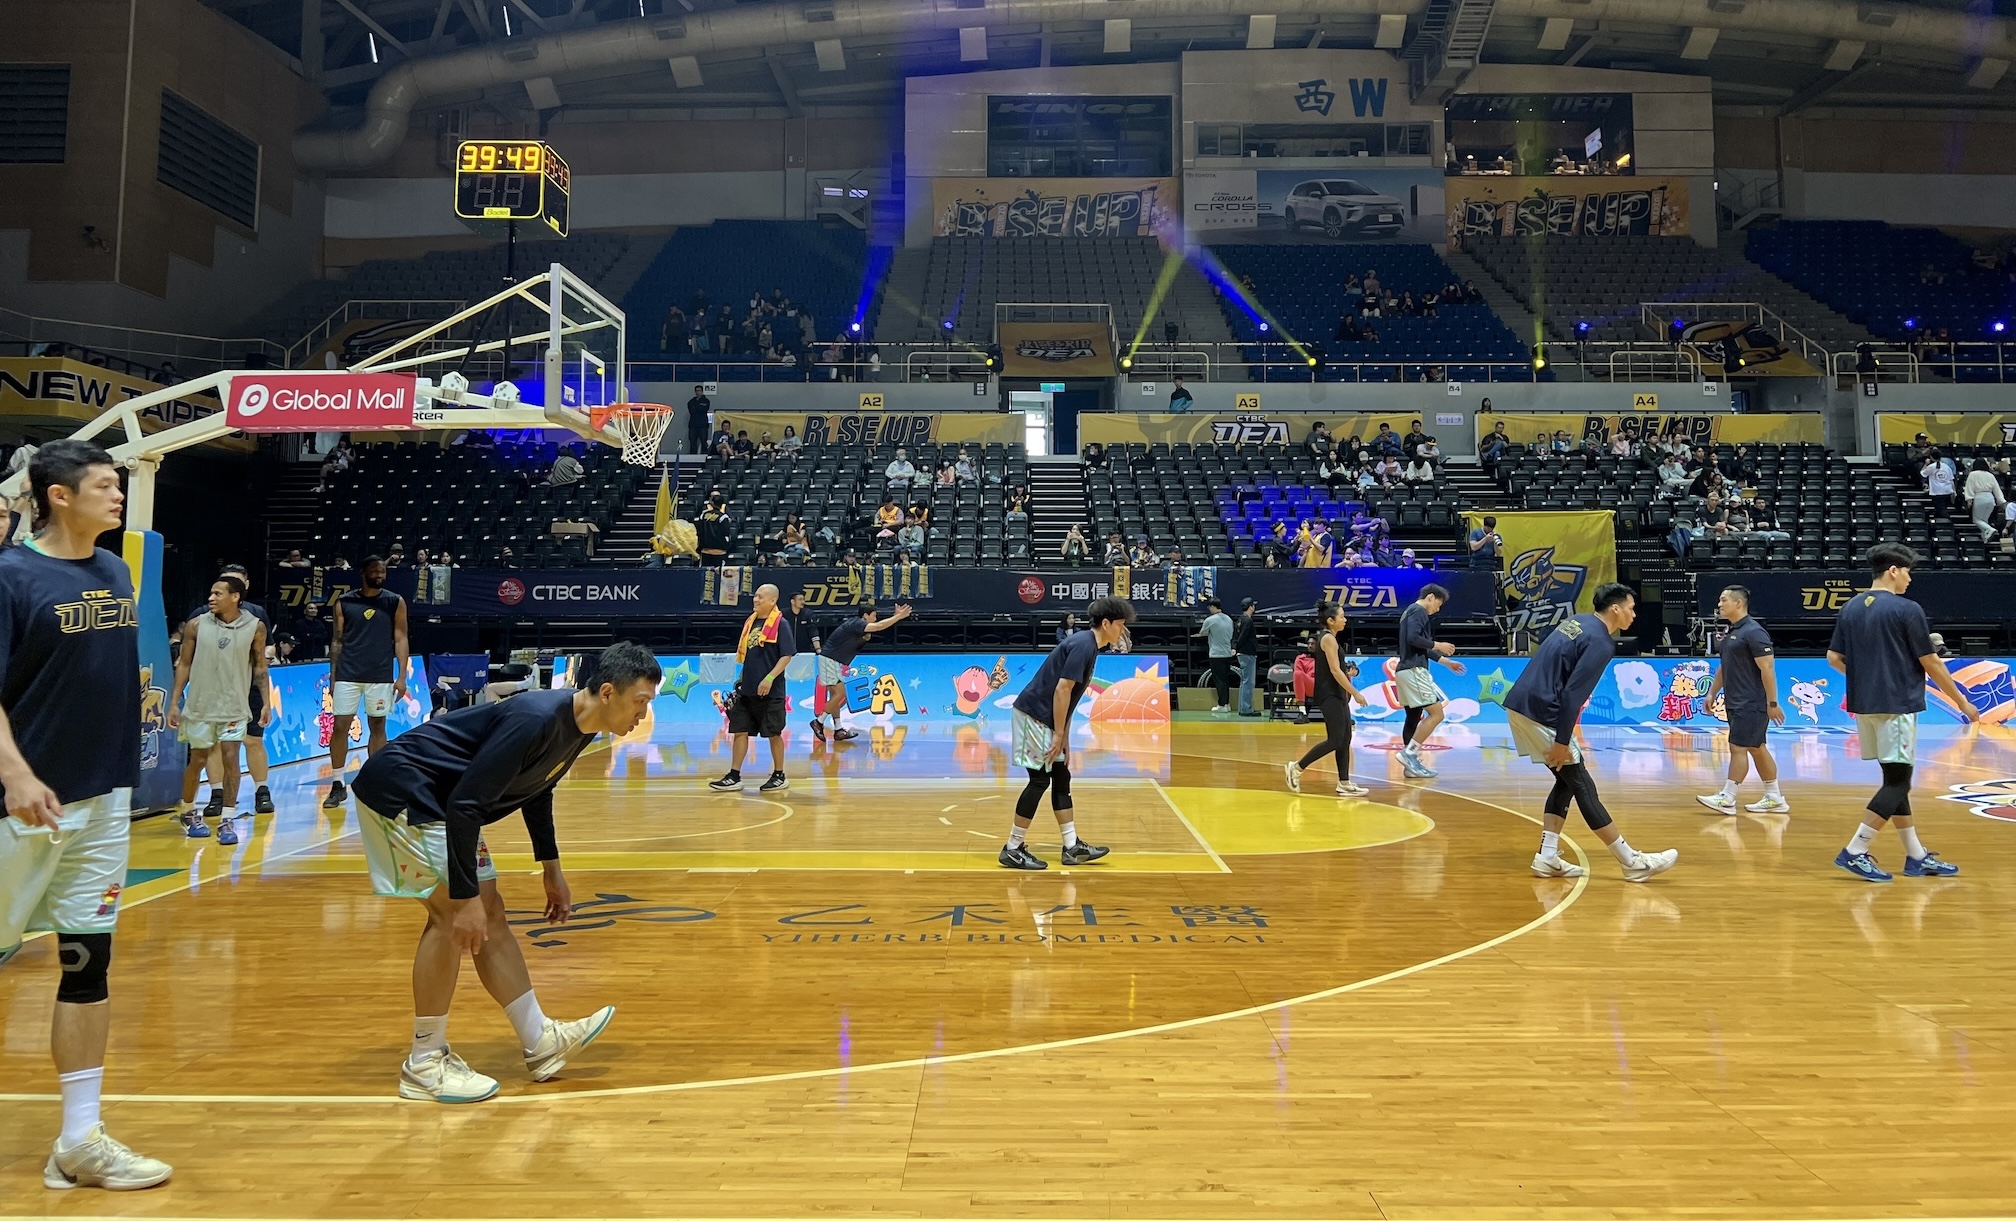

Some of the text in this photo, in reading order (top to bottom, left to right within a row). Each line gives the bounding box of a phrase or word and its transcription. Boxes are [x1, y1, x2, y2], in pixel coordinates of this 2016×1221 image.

[1294, 78, 1387, 117] 西 W
[462, 145, 540, 170] 39:49
[1194, 202, 1272, 211] CROSS
[1020, 348, 1096, 358] DEA
[0, 370, 217, 424] NEW TAIPE
[272, 387, 405, 410] Global Mall
[862, 397, 882, 407] A2
[1238, 398, 1259, 408] A3
[1636, 397, 1656, 406] A4
[1211, 422, 1290, 445] DEA
[82, 590, 112, 599] CTBC
[532, 584, 640, 601] CTBC BANK
[1051, 582, 1165, 600] 中國信銀行
[1323, 585, 1398, 607] DEA
[1525, 598, 1551, 608] CTBC
[54, 599, 139, 634] DEA
[1506, 601, 1575, 632] DEA
[761, 933, 1285, 943] YIHERB BIOMEDICAL
